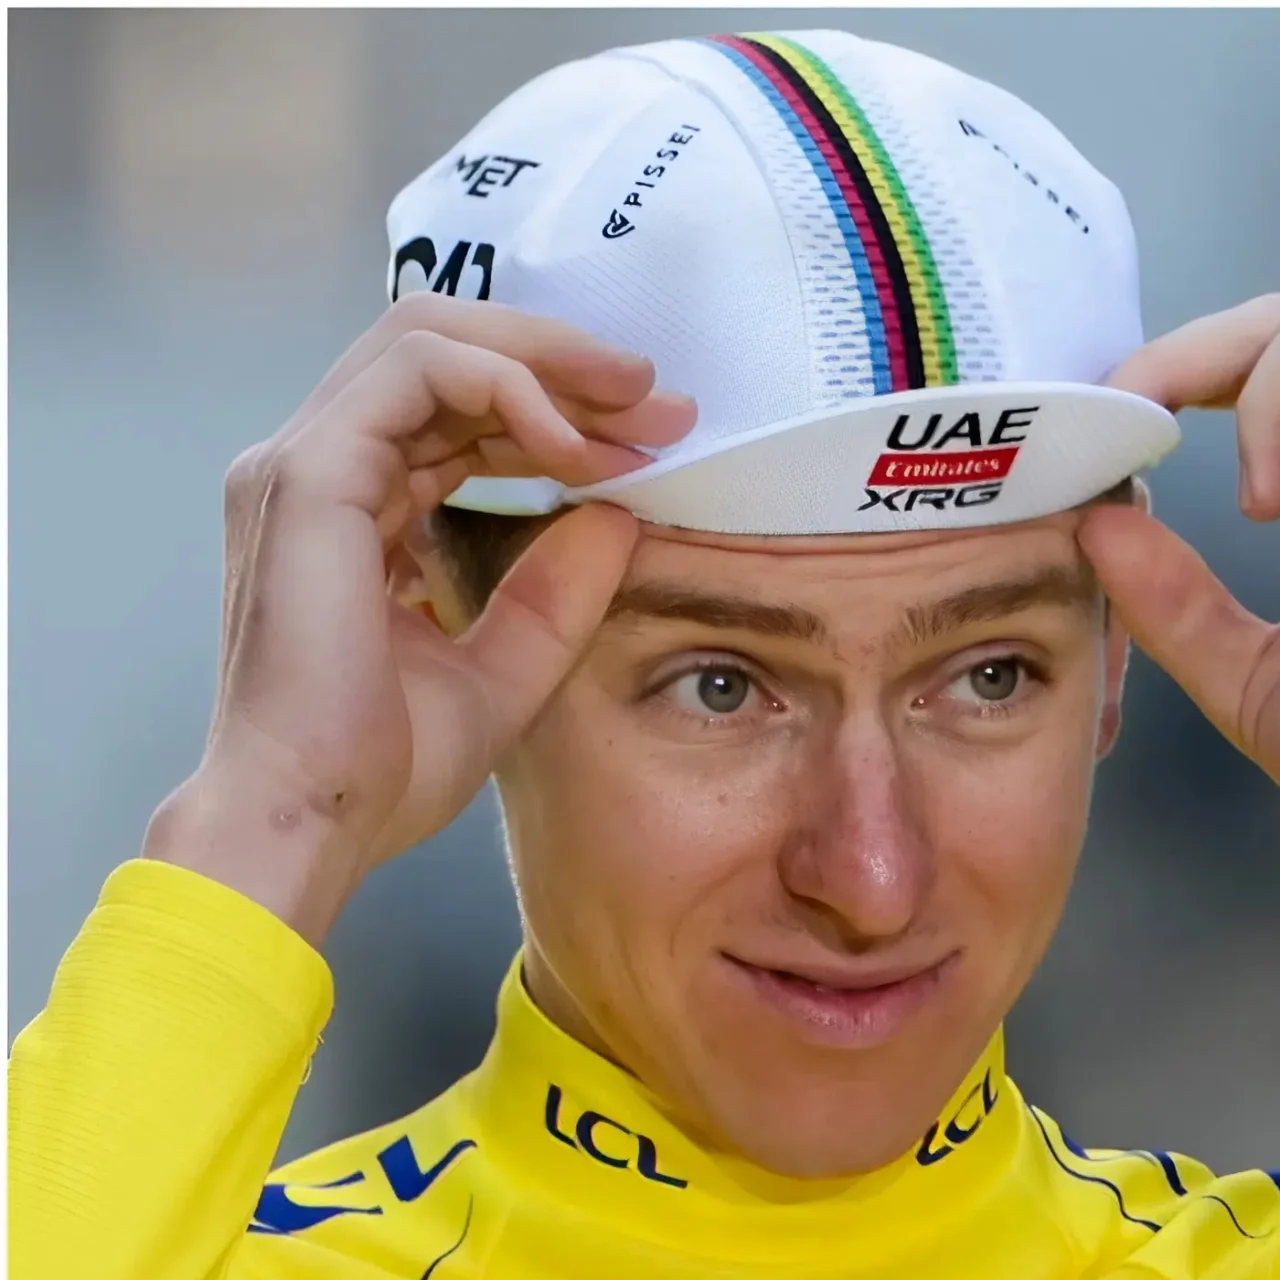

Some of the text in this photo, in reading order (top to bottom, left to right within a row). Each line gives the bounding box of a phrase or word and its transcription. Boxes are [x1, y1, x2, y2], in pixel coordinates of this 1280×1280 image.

[456, 154, 543, 198] MET
[623, 124, 701, 207] PISSEI
[886, 406, 1041, 451] UAE
[885, 458, 999, 479] Emirates
[857, 482, 1003, 512] XRG
[544, 1082, 688, 1189] LCL
[247, 1134, 478, 1235] CL
